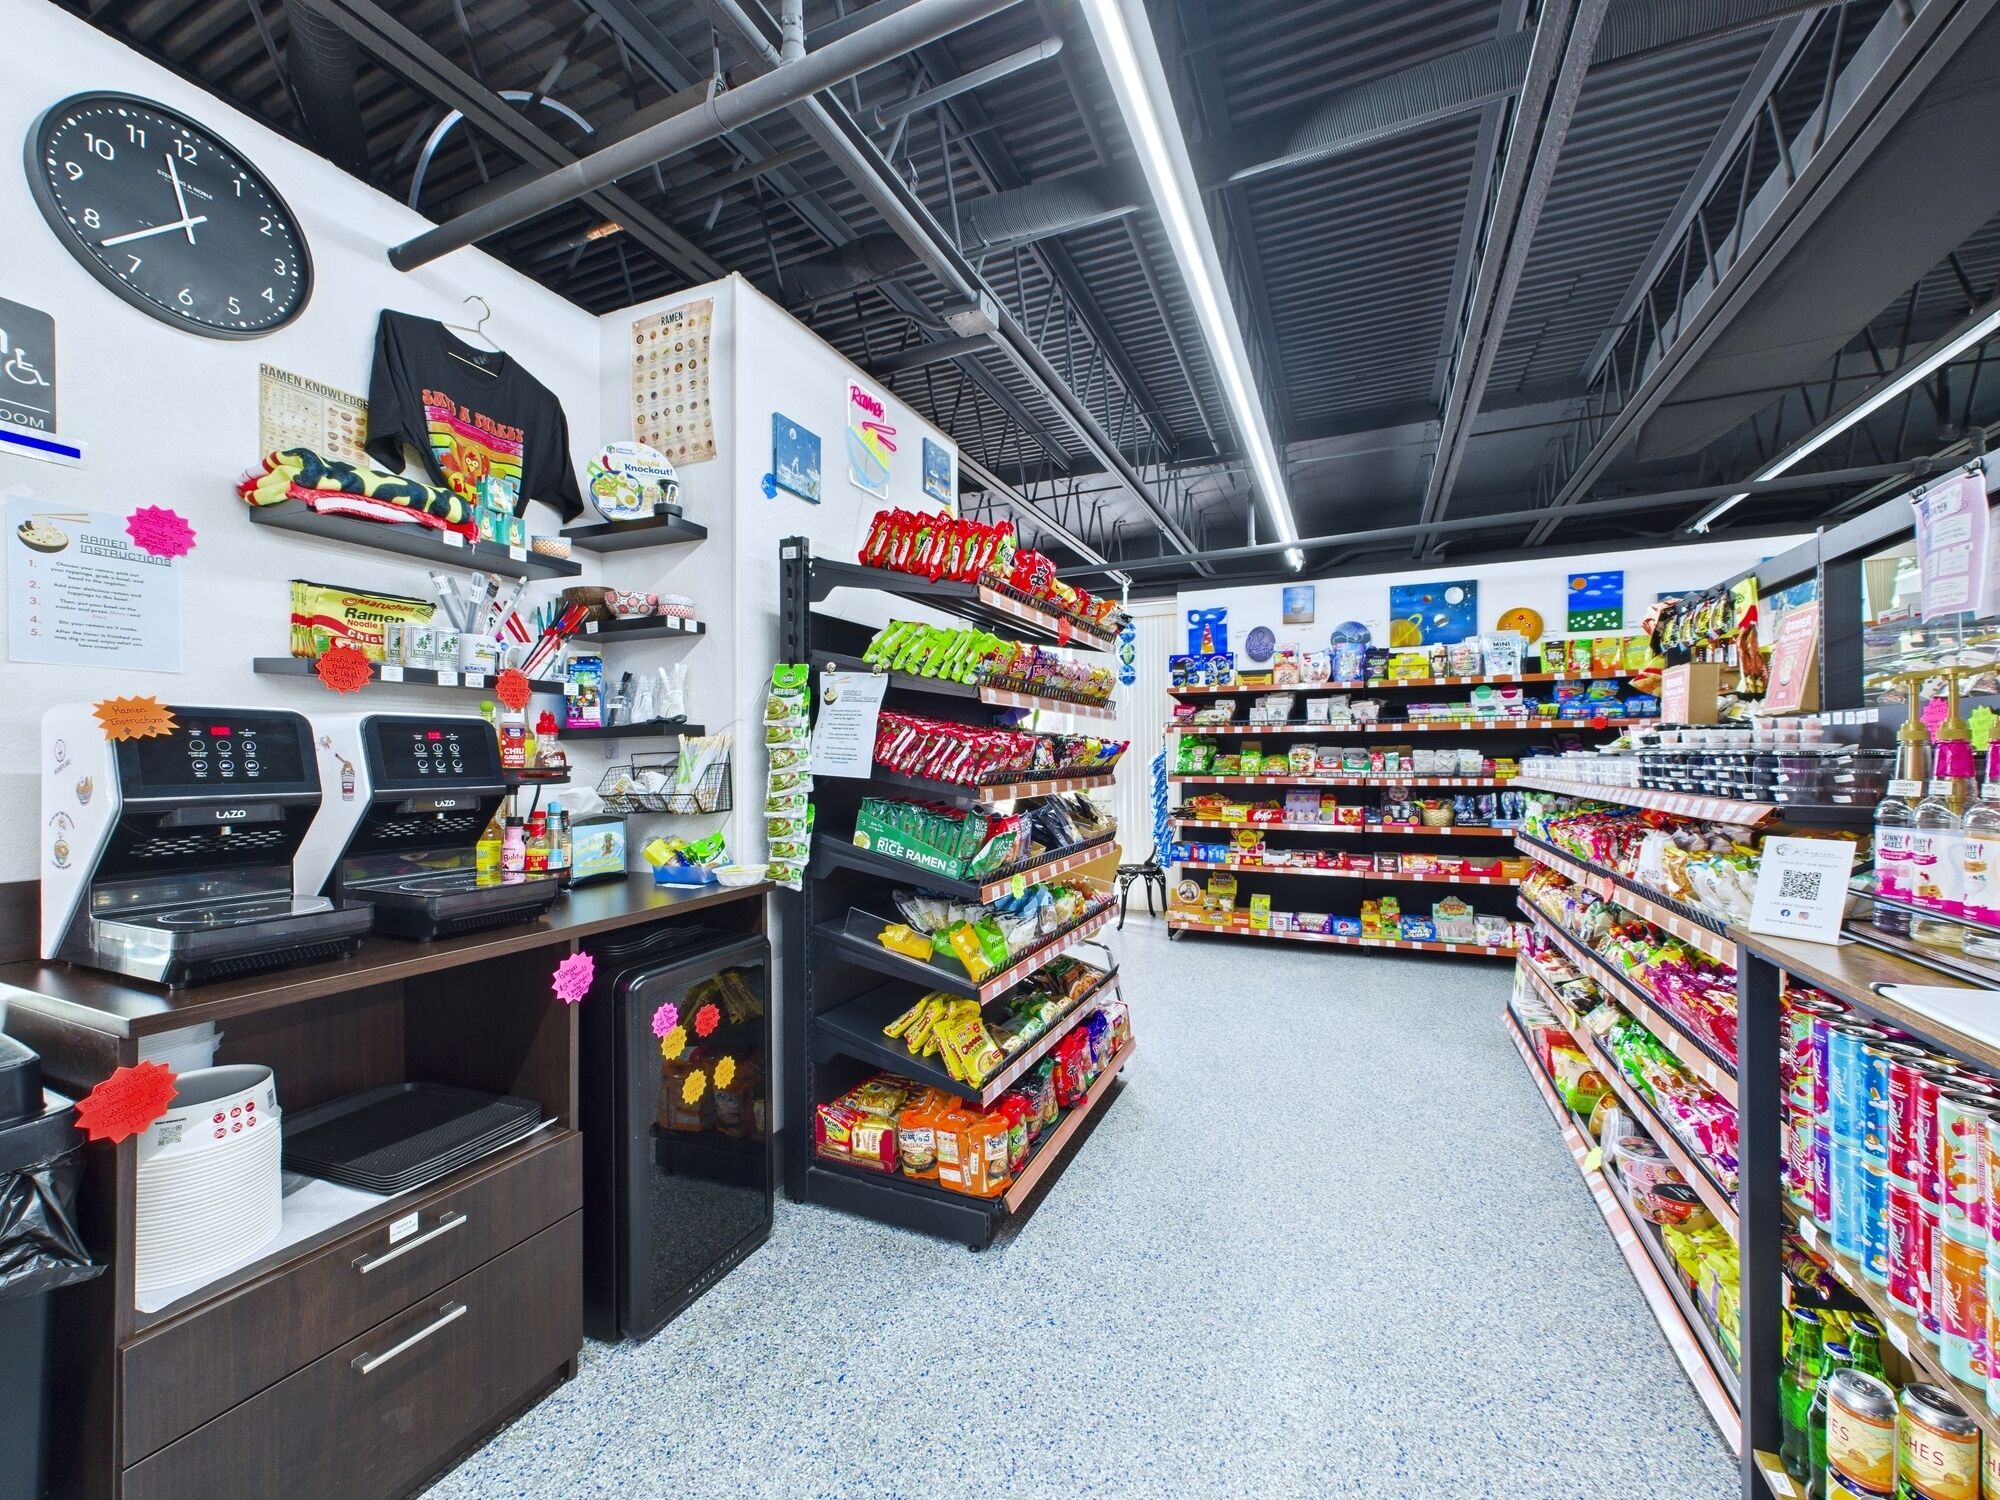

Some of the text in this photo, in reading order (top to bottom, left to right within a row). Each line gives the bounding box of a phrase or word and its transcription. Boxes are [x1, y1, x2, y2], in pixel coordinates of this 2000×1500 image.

[126, 124, 146, 148] 11
[83, 132, 115, 161] 10
[174, 139, 198, 166] 12
[65, 161, 84, 181] 9
[232, 179, 242, 197] 1
[83, 208, 101, 229] 8
[259, 216, 273, 236] 2
[127, 254, 142, 273] 7
[273, 258, 287, 276] 3
[178, 288, 194, 306] 6
[260, 287, 275, 303] 4
[227, 296, 241, 315] 5
[661, 311, 684, 326] RAMEN
[260, 363, 369, 410] RAMEN KNOWLEDGE
[459, 405, 471, 424] A
[624, 463, 673, 476] Knockout!
[80, 534, 128, 550] RAMEN
[80, 544, 172, 567] INSTRUCTIONS
[356, 598, 415, 613] Maruchan
[344, 608, 405, 624] Ramen
[347, 619, 378, 629] Noodle
[111, 704, 148, 714] Ramen
[109, 715, 165, 727] Instructions
[434, 799, 456, 808] LAZO
[216, 809, 247, 819] LAZO
[1881, 833, 1904, 841] SKINNY
[1883, 841, 1903, 849] MIXES
[876, 839, 947, 871] RICE RAMEN
